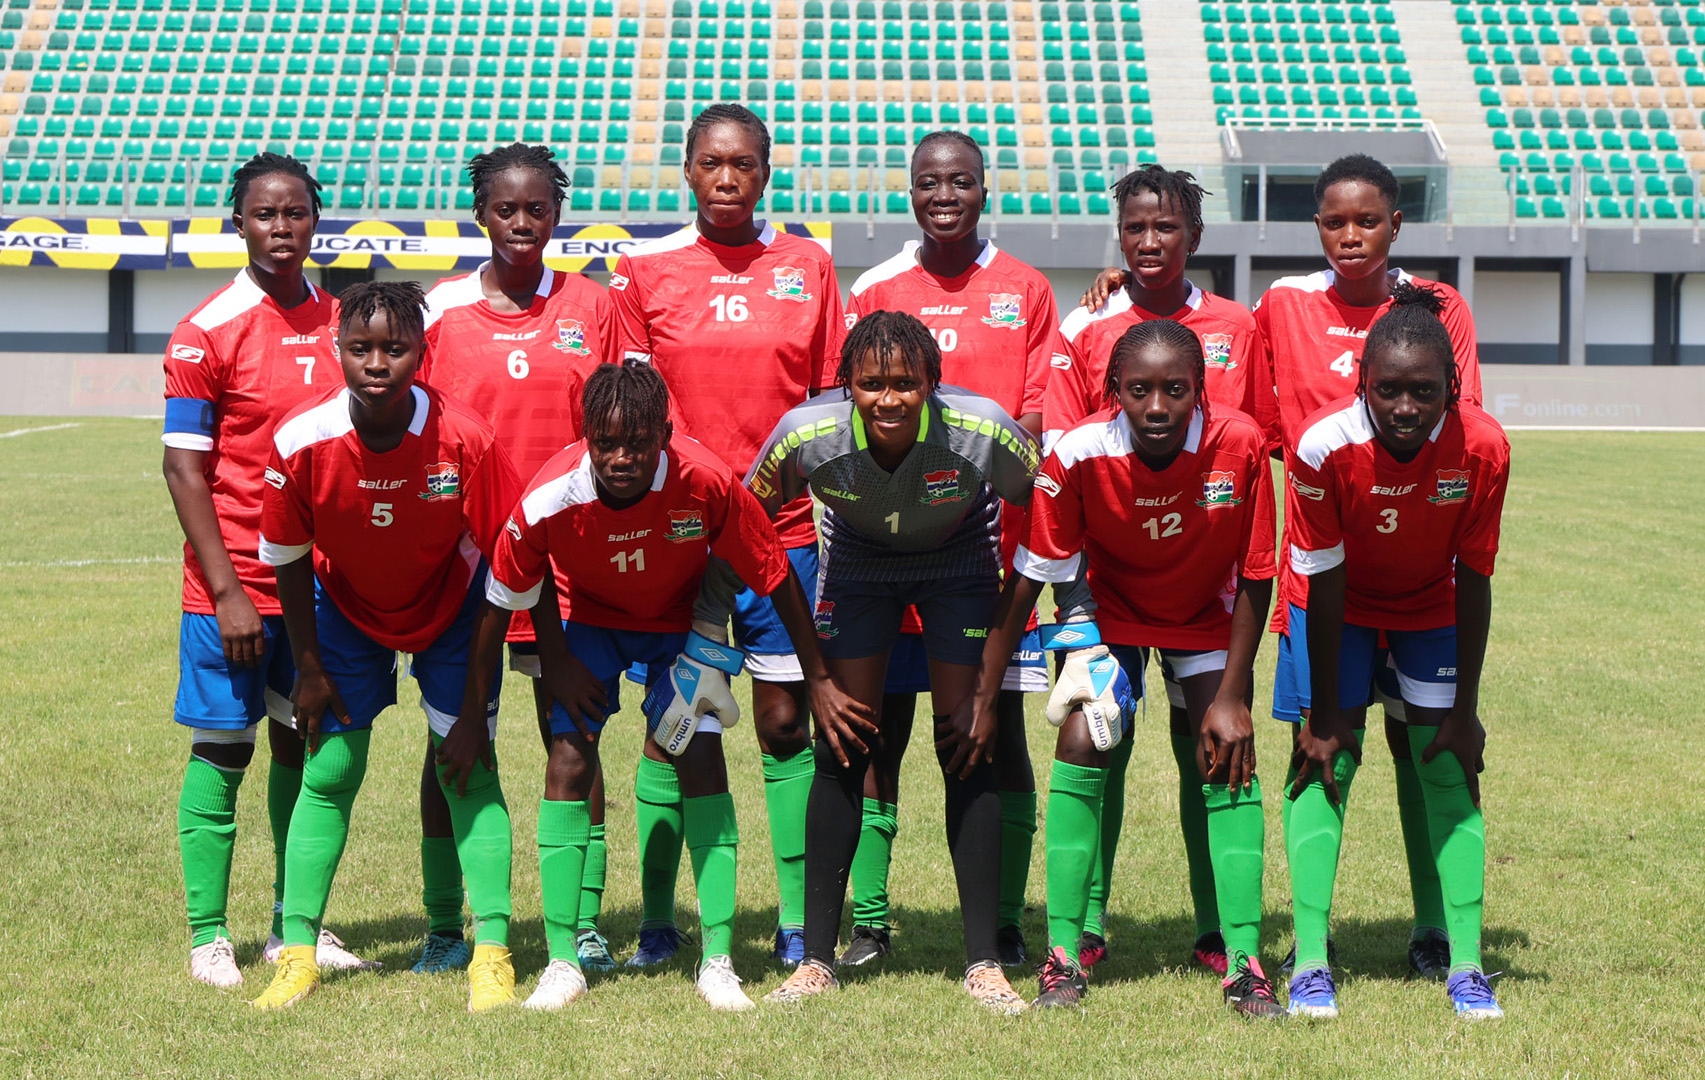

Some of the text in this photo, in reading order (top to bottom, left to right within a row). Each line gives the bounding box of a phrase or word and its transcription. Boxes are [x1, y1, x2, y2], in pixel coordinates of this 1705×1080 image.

[0, 235, 88, 249] AGE.
[709, 274, 754, 285] saller
[709, 294, 749, 322] 16
[920, 304, 968, 315] saller
[281, 334, 320, 345] saller
[295, 356, 316, 385] 7
[507, 349, 530, 380] 6
[1329, 350, 1354, 378] 4
[357, 479, 408, 490] saller
[1370, 483, 1418, 496] saller
[1135, 491, 1183, 507] saller
[370, 502, 394, 527] 5
[884, 511, 900, 534] 1
[1142, 512, 1183, 540] 12
[1376, 508, 1399, 534] 3
[608, 529, 652, 542] saller
[610, 548, 645, 573] 11
[669, 717, 692, 752] umbro
[1092, 708, 1108, 747] umbro
